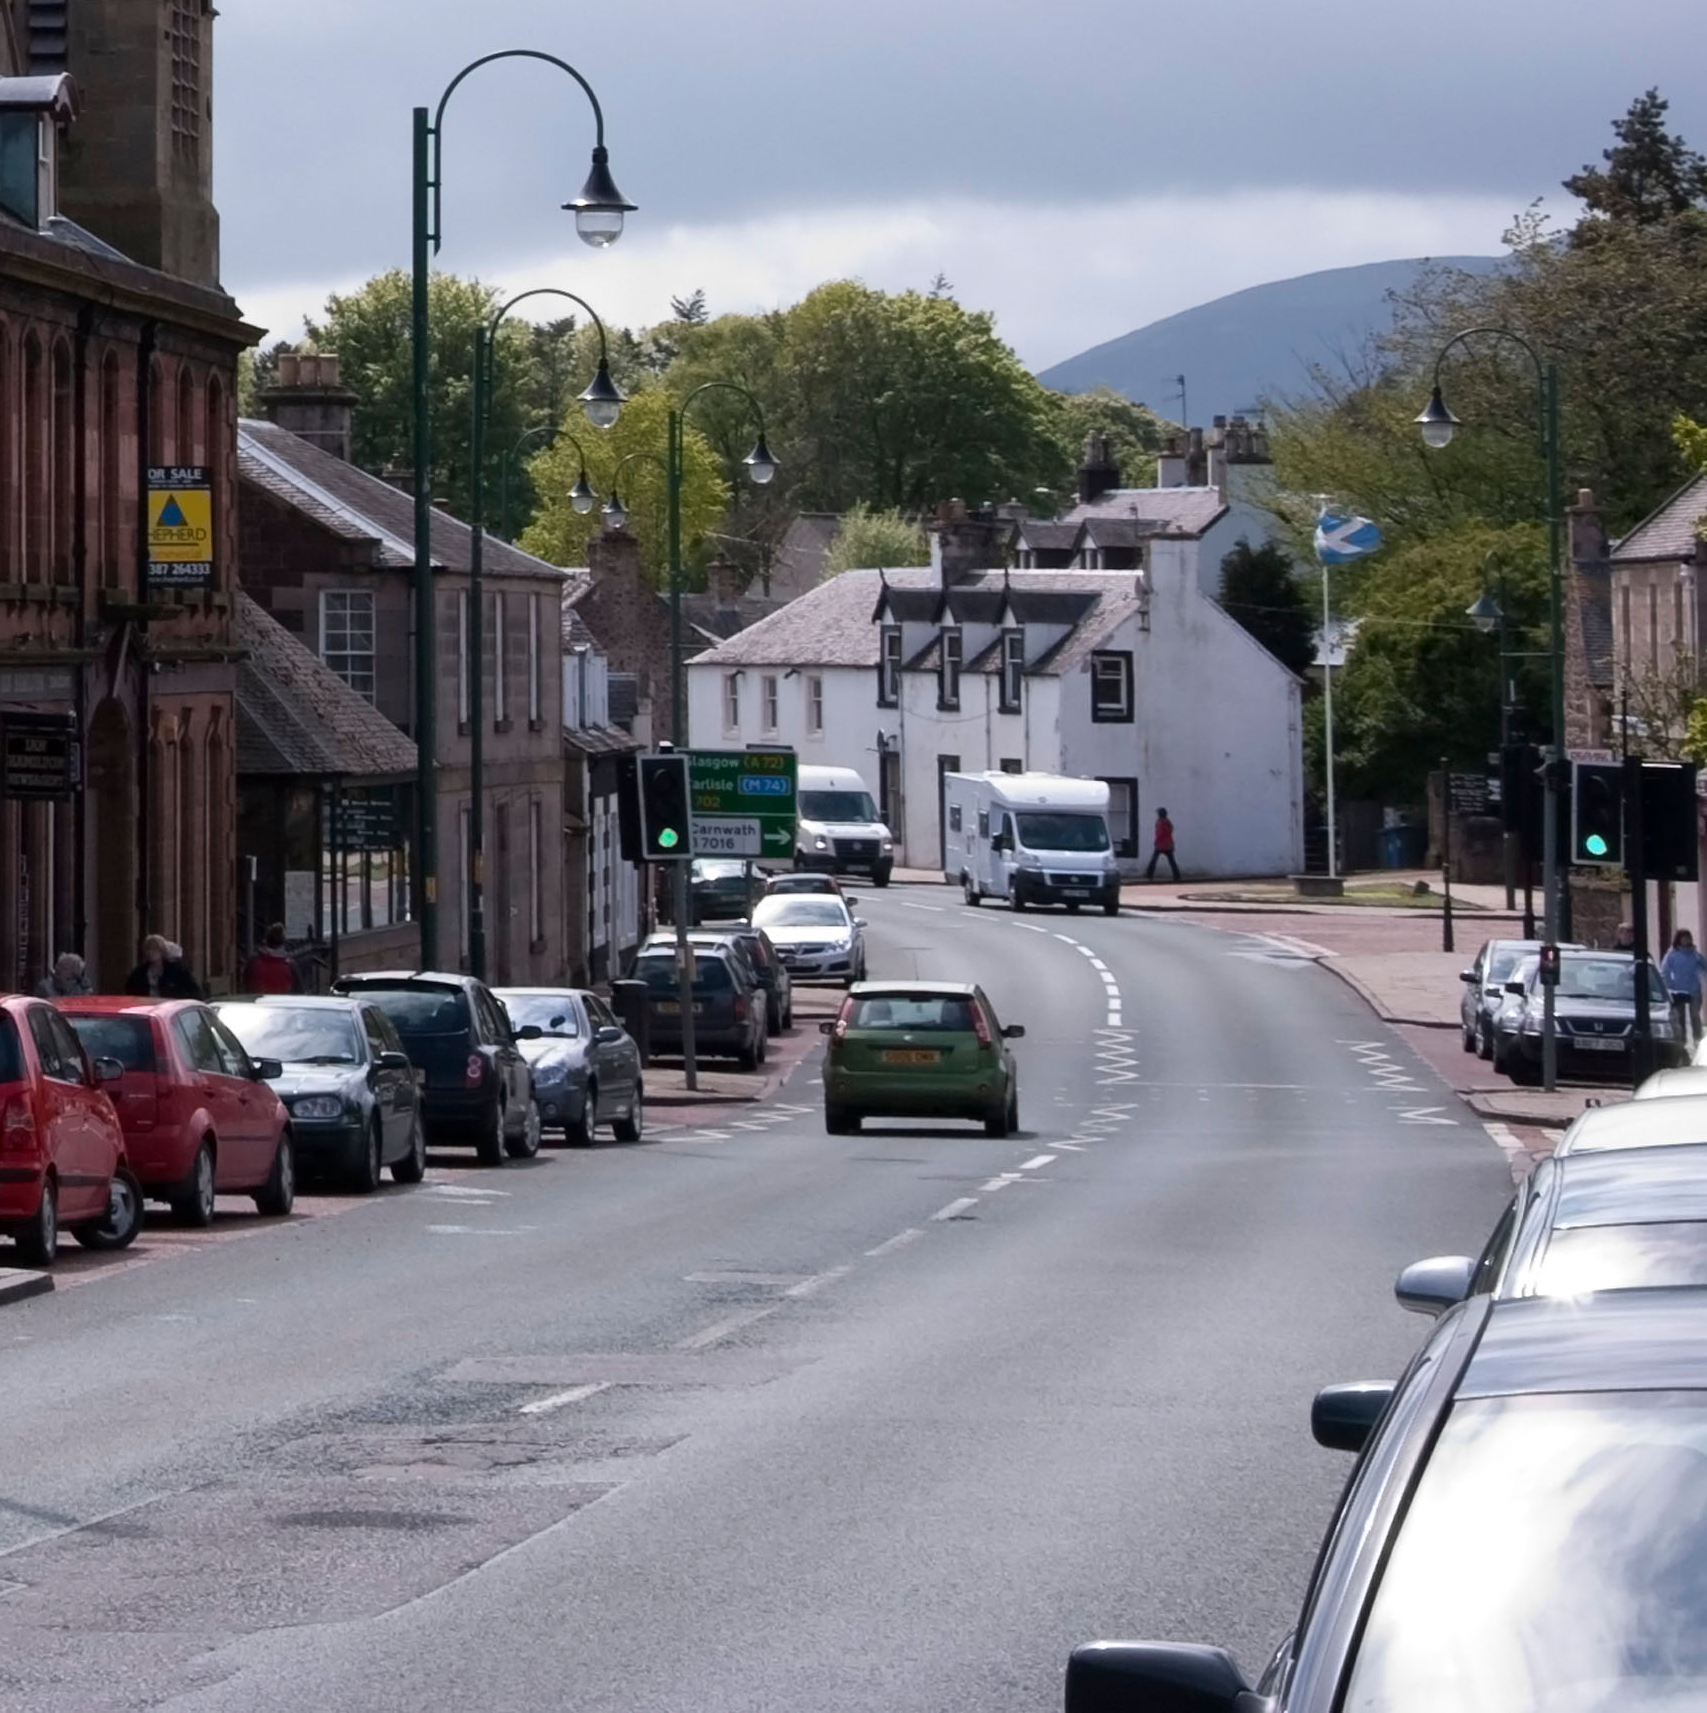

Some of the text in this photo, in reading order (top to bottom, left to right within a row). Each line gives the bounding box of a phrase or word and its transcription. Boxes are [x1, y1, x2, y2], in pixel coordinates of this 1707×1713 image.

[148, 468, 202, 480] OR SALE
[148, 527, 207, 542] HEPHERD
[690, 778, 734, 792] arlisle
